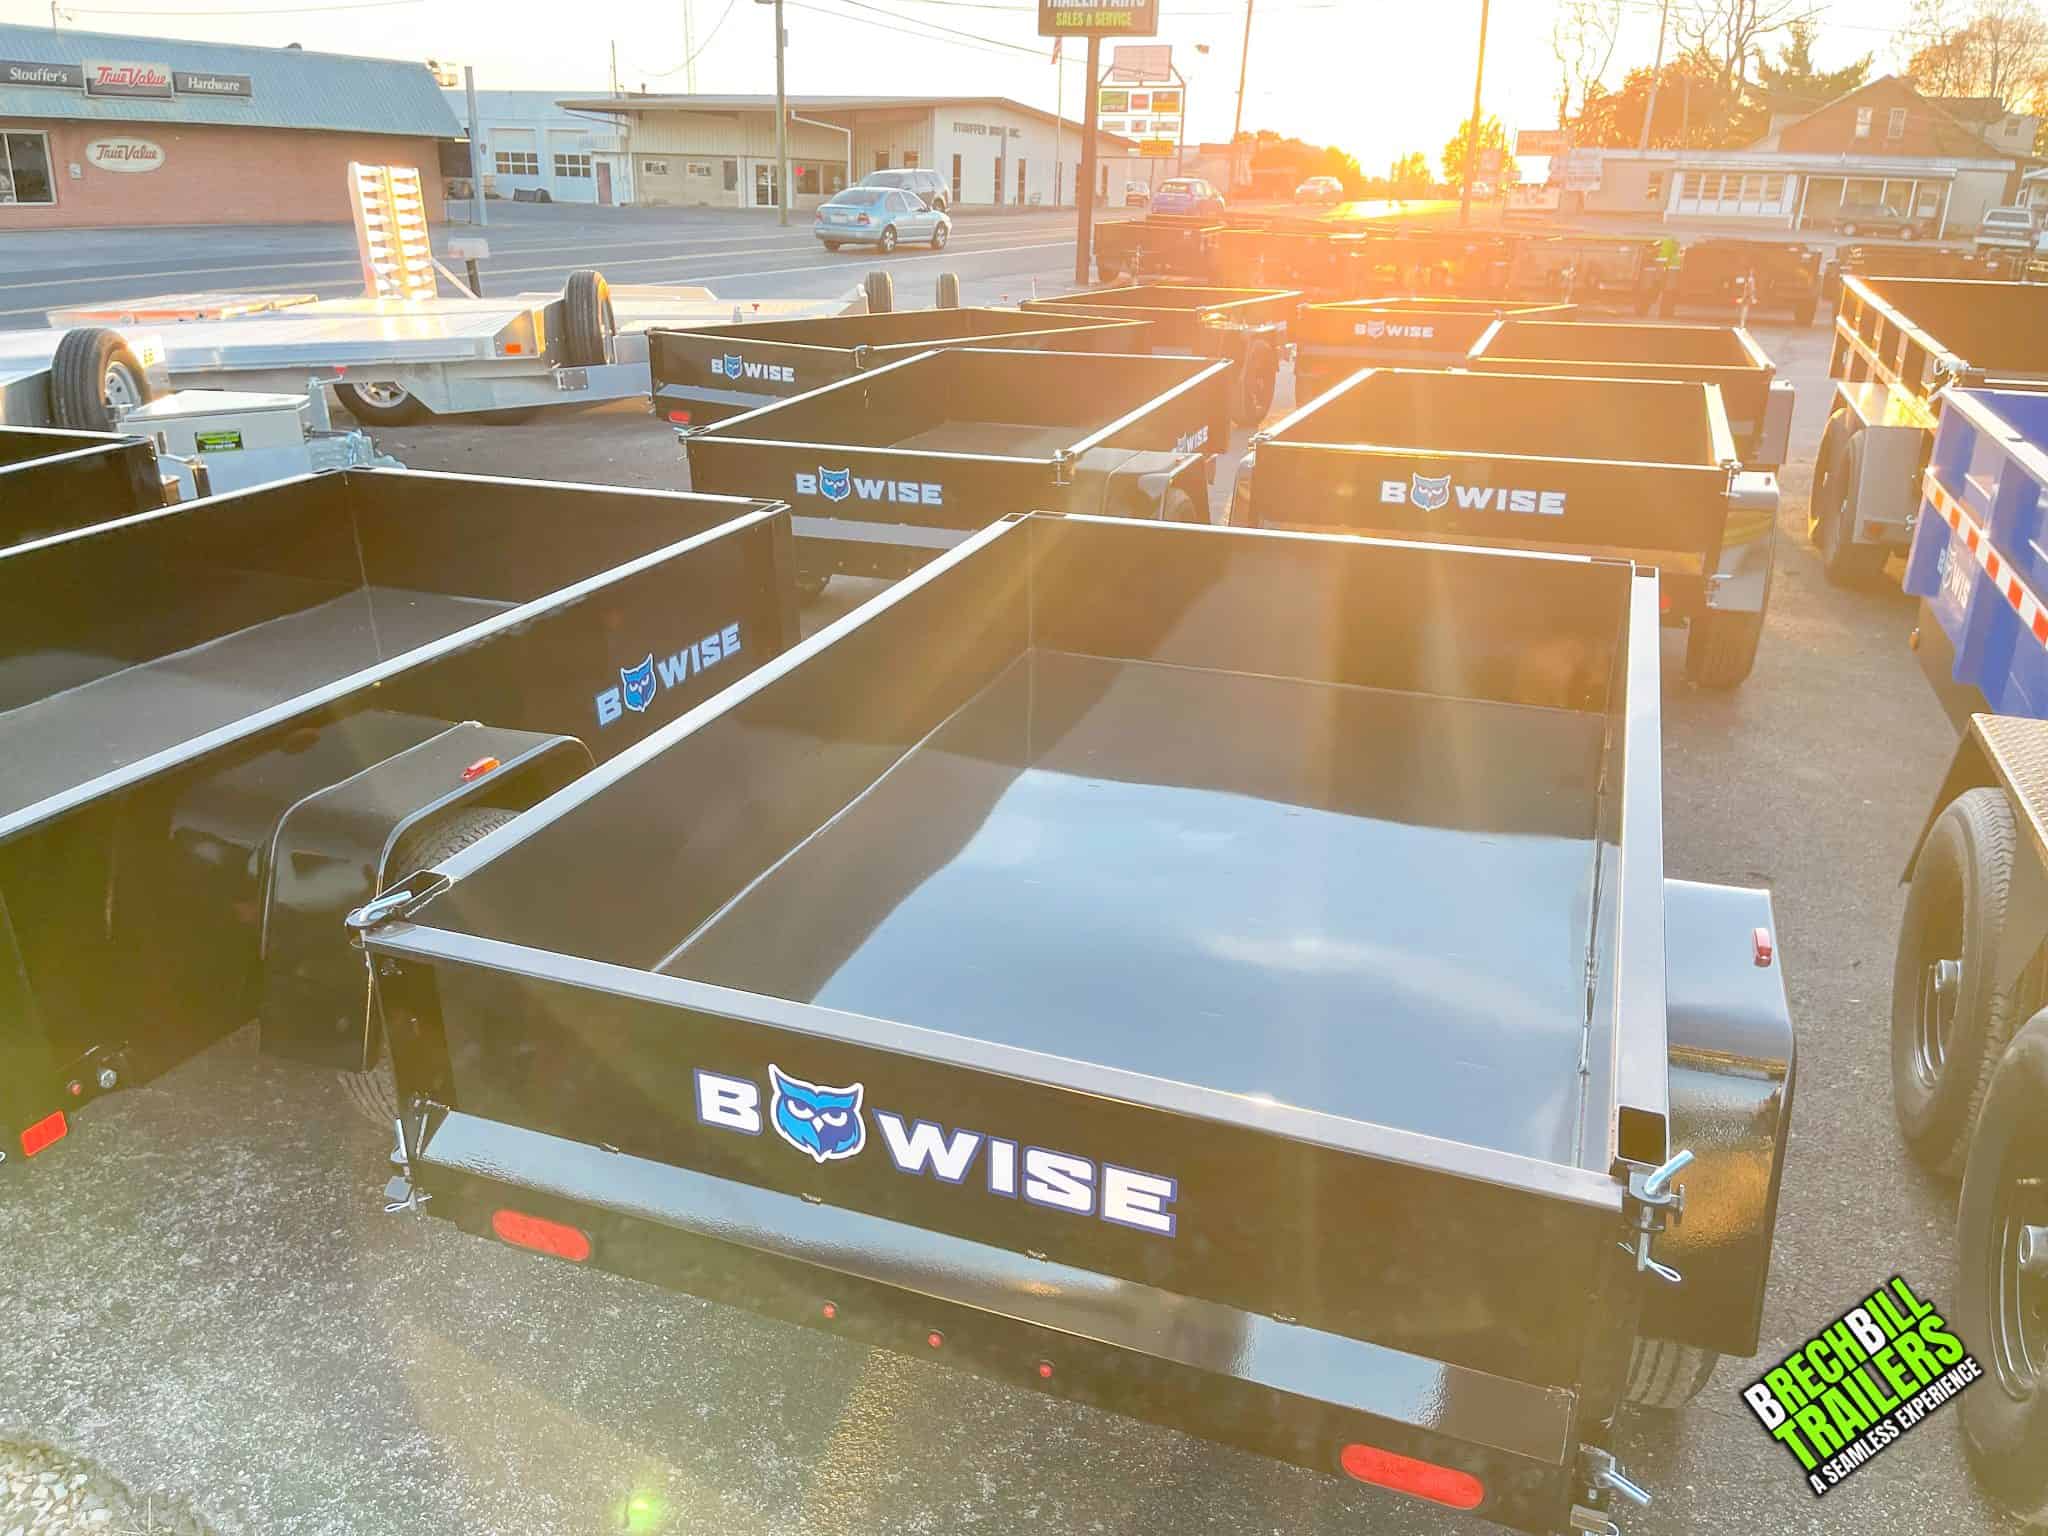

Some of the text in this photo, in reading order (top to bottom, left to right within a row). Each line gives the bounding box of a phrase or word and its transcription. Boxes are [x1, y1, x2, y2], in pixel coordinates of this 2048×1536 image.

[1056, 11, 1083, 26] SALES
[1095, 11, 1133, 27] SERVICE
[9, 66, 68, 83] Stouffer's
[188, 76, 240, 92] Hardware
